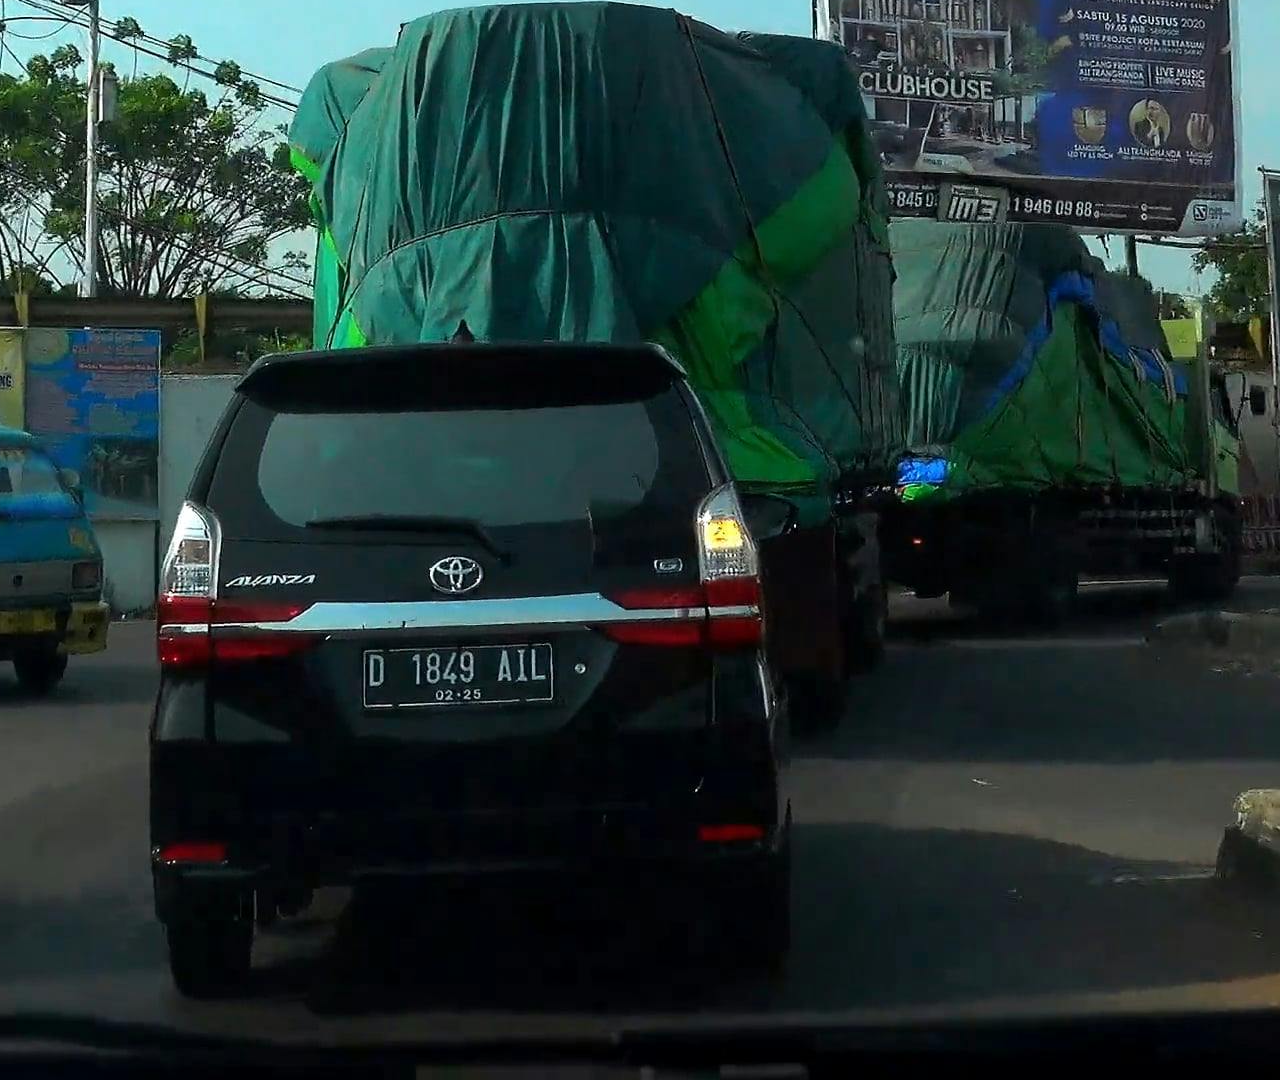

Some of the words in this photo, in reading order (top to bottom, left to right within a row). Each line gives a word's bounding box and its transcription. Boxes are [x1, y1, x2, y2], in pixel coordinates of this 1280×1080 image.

[1130, 14, 1179, 28] AGUSTUS
[1181, 17, 1206, 30] 2020
[1155, 65, 1175, 77] LIVE
[1176, 68, 1206, 80] MUSIC
[859, 71, 994, 100] CLUBHOUSE
[896, 190, 923, 208] 845
[1023, 198, 1051, 215] 946
[1055, 200, 1073, 216] 09
[1075, 201, 1093, 218] 88
[225, 574, 316, 588] AVANZA
[369, 654, 385, 687] D
[412, 651, 475, 686] 1849
[497, 648, 547, 683] AIL
